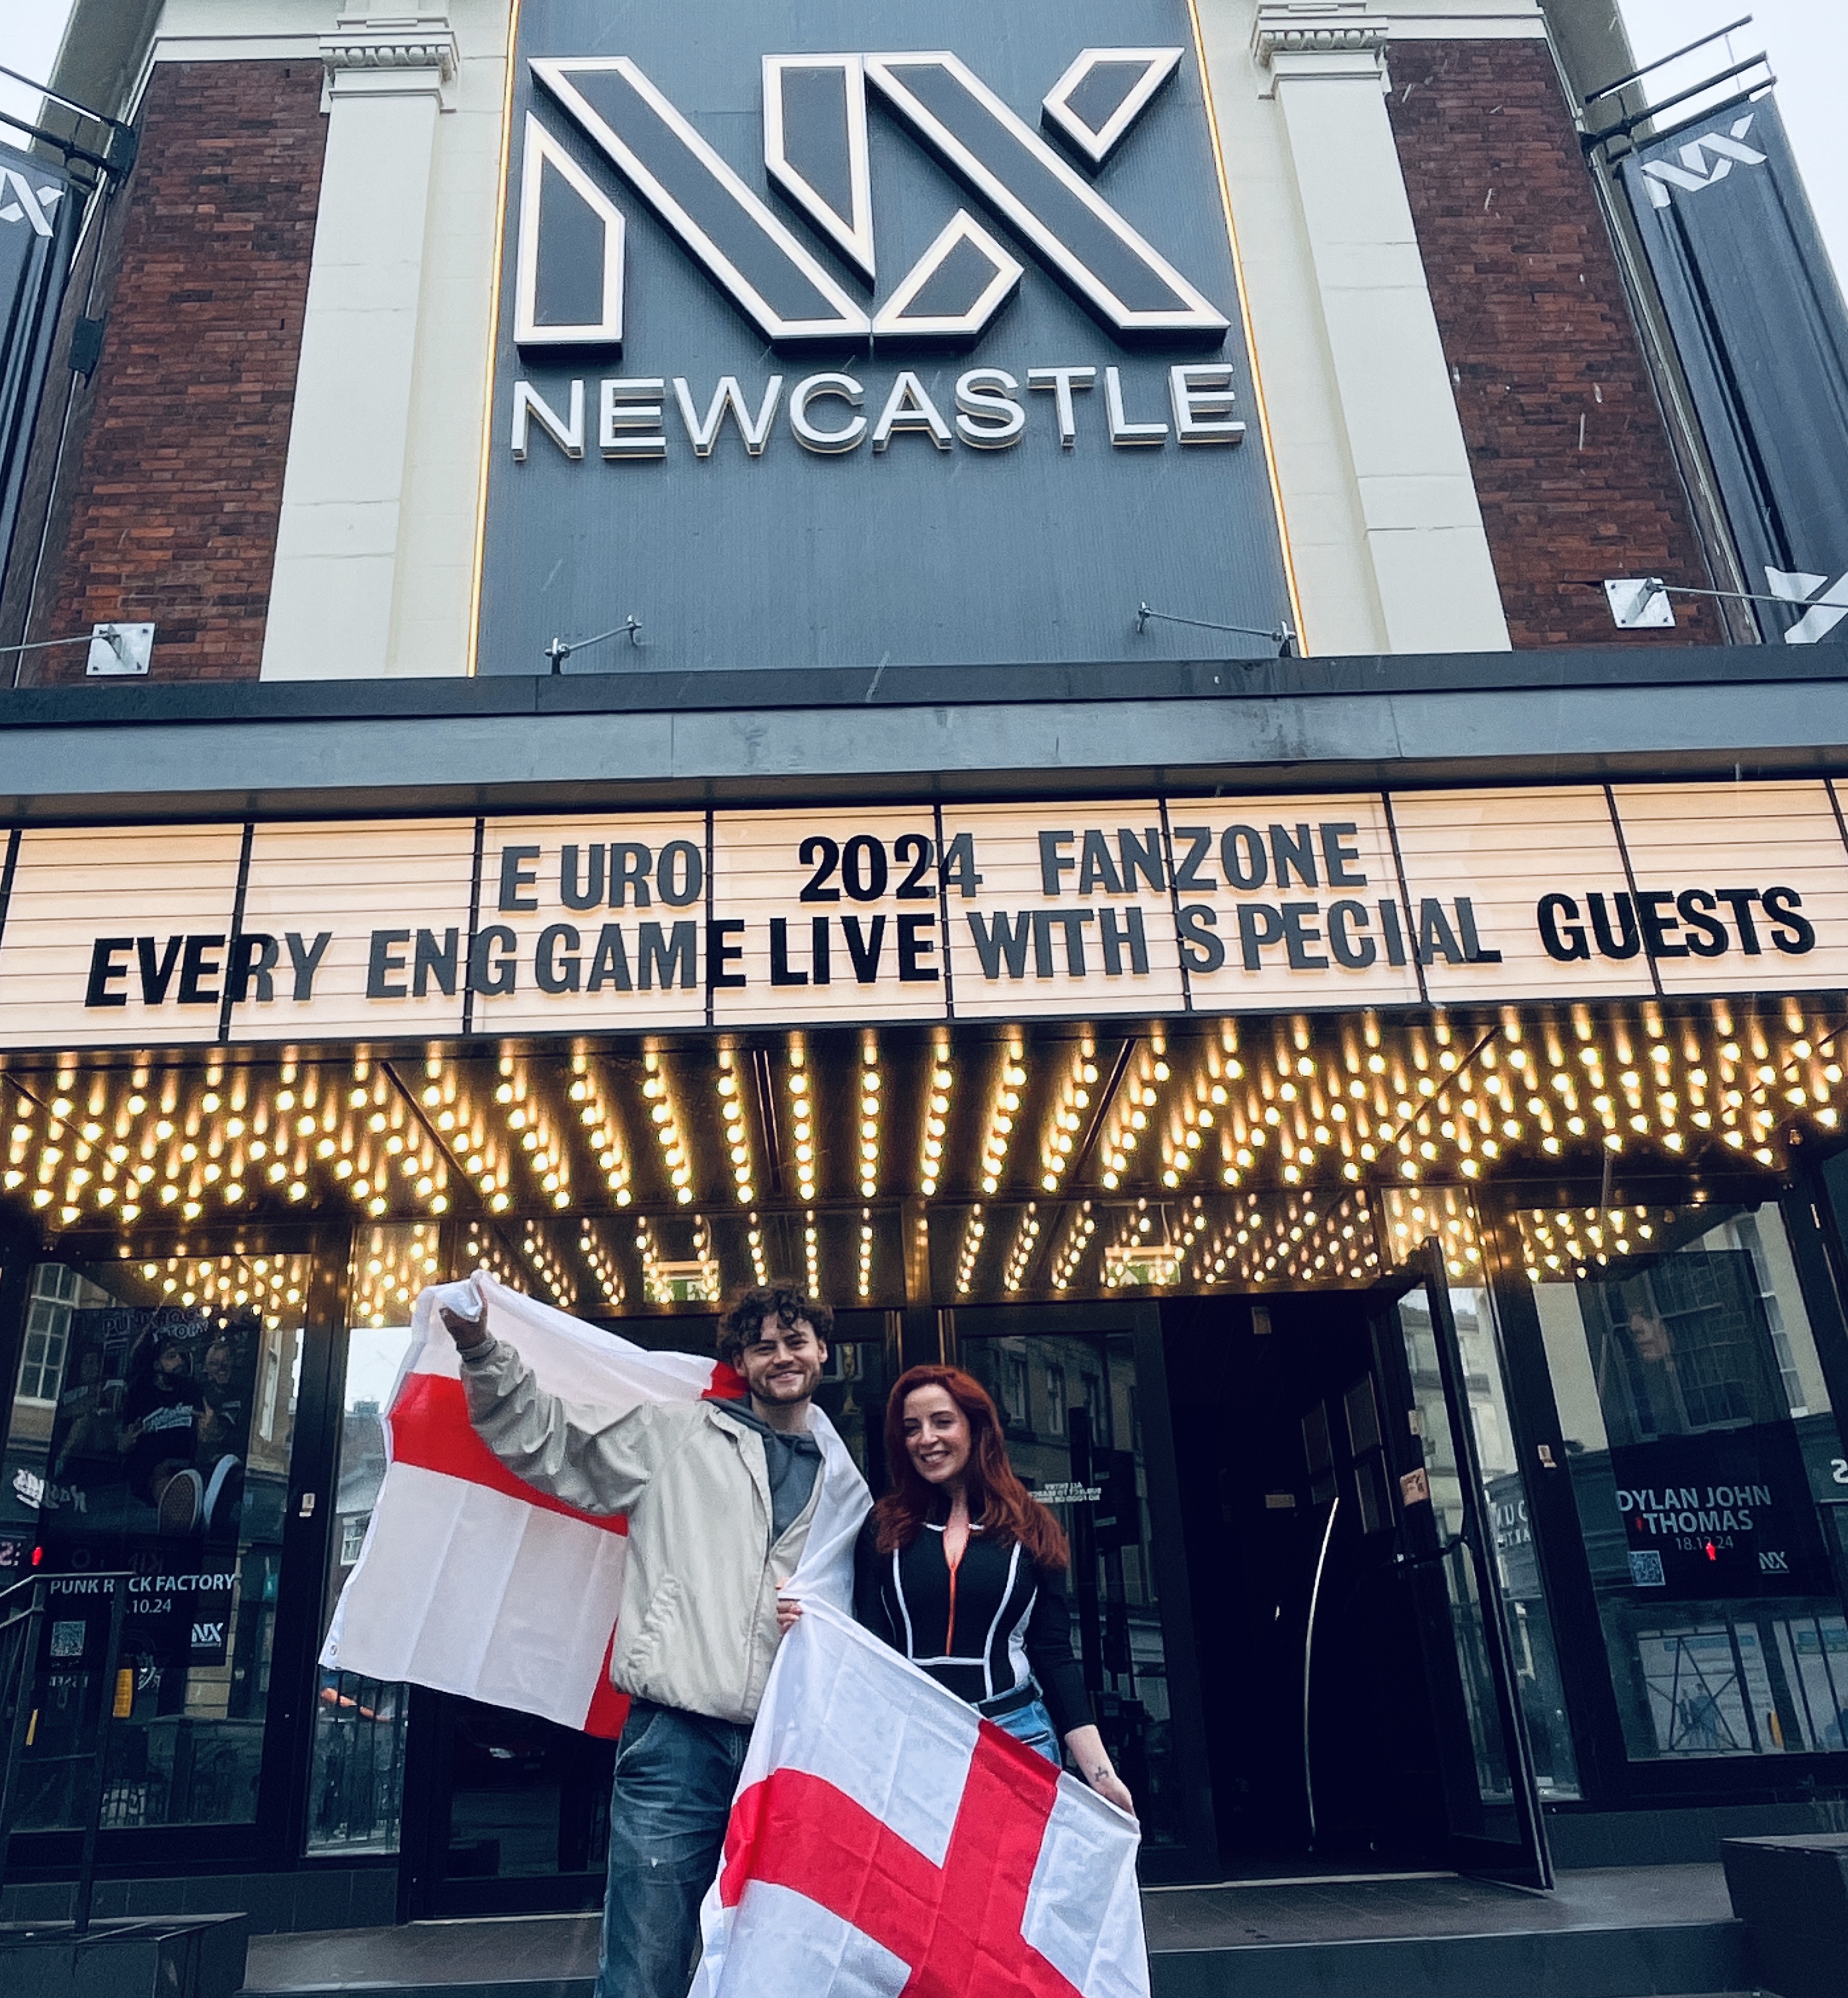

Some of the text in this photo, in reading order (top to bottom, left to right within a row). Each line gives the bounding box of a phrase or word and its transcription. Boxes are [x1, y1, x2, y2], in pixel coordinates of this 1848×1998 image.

[513, 47, 1230, 357] NX
[511, 363, 1246, 460] NEWCASTLE
[499, 822, 1367, 912] EURO 2024 FANZONE
[85, 886, 1816, 1008] EVERY ENG GAME LIVE WITH SPECIAL GUESTS
[1616, 1484, 1773, 1512] DYLAN JOHN
[1642, 1509, 1754, 1535] THOMAS
[50, 1574, 235, 1595] PUNK RCK FACTORY
[110, 1599, 172, 1615] .10.24
